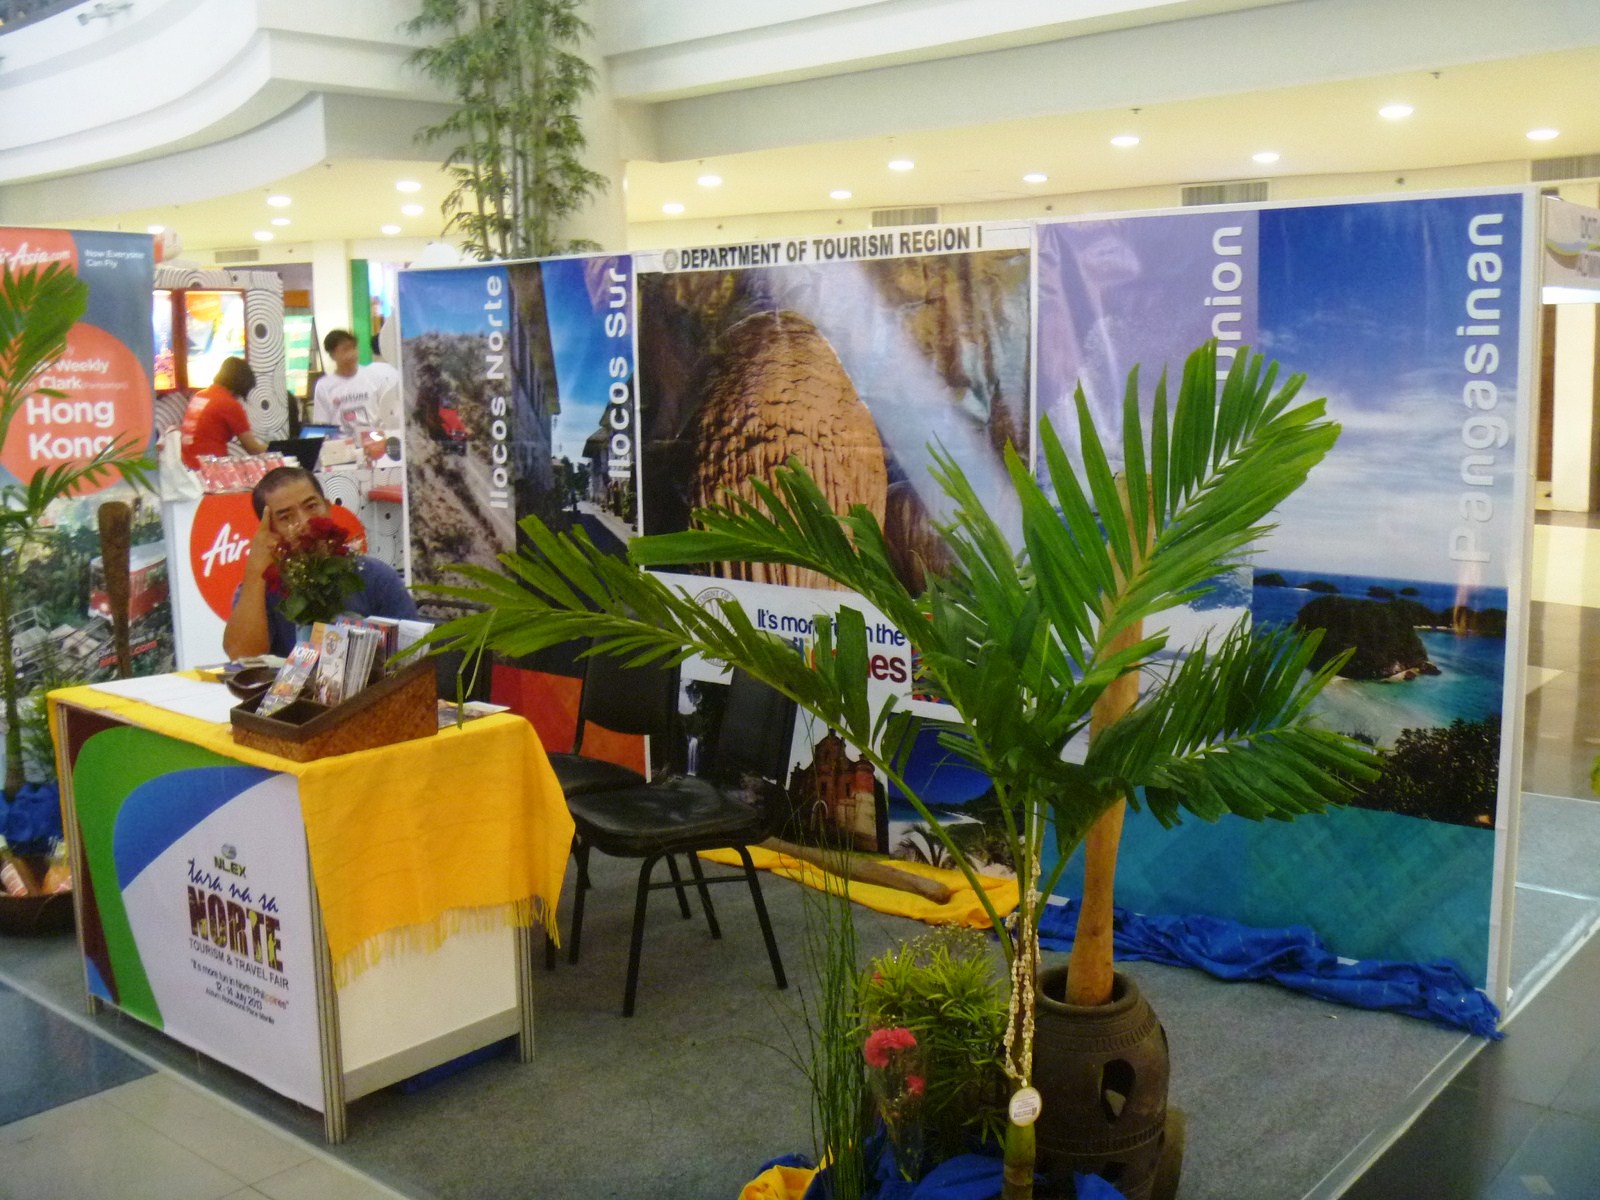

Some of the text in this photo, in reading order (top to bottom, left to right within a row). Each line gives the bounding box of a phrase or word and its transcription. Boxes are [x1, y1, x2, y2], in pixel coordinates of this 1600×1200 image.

[681, 225, 983, 269] DEPARTMENT OF TOURISM REGION I
[57, 359, 110, 374] Weekly
[604, 268, 632, 479] Ilocos Sur
[1448, 212, 1508, 563] Pangasinan
[26, 398, 115, 428] Hong
[484, 275, 508, 510] Ilocos Norte
[757, 608, 778, 630] It's
[781, 615, 818, 635] mor
[876, 623, 906, 647] the
[188, 858, 223, 892] tara
[214, 856, 247, 878] NLEX
[187, 885, 284, 974] NORTE
[189, 938, 290, 992] TOURISM & TRAVEL FAIR
